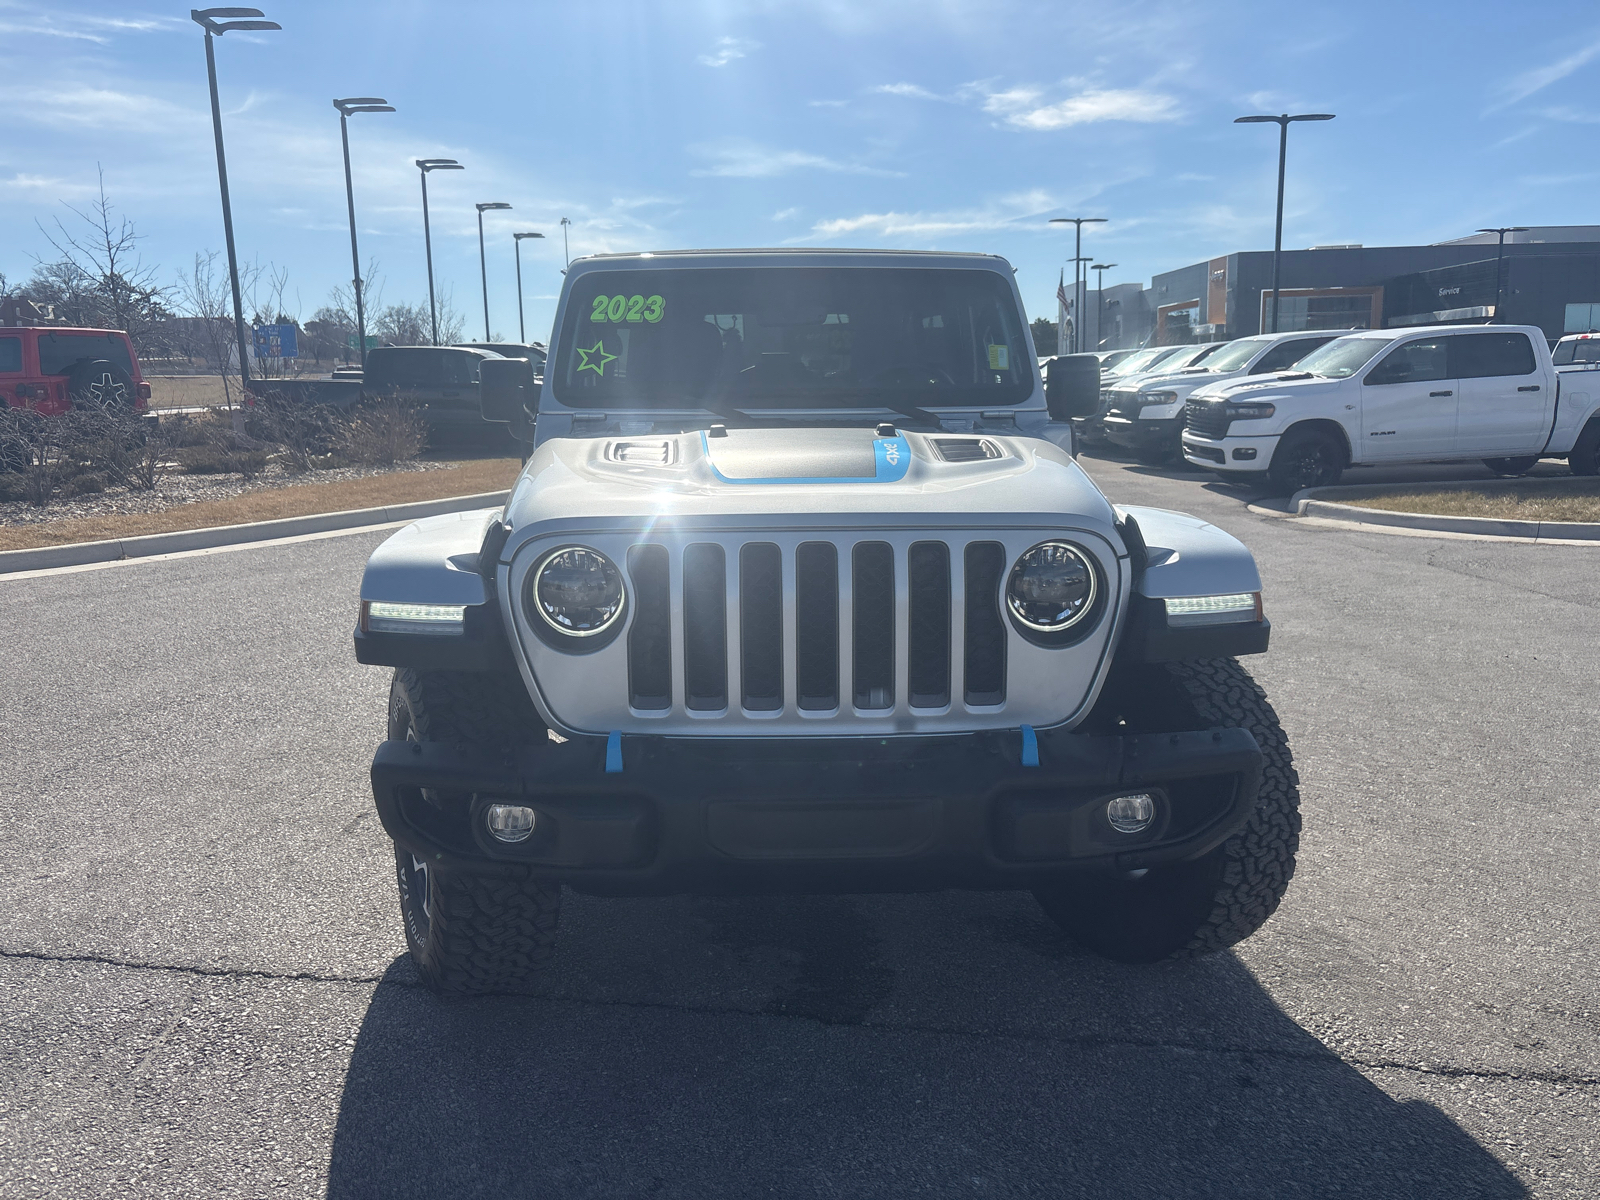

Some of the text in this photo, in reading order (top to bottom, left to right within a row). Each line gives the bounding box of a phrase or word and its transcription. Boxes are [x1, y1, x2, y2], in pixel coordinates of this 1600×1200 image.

[1438, 286, 1461, 297] Service
[590, 294, 666, 323] 2023
[883, 443, 900, 466] 4xe
